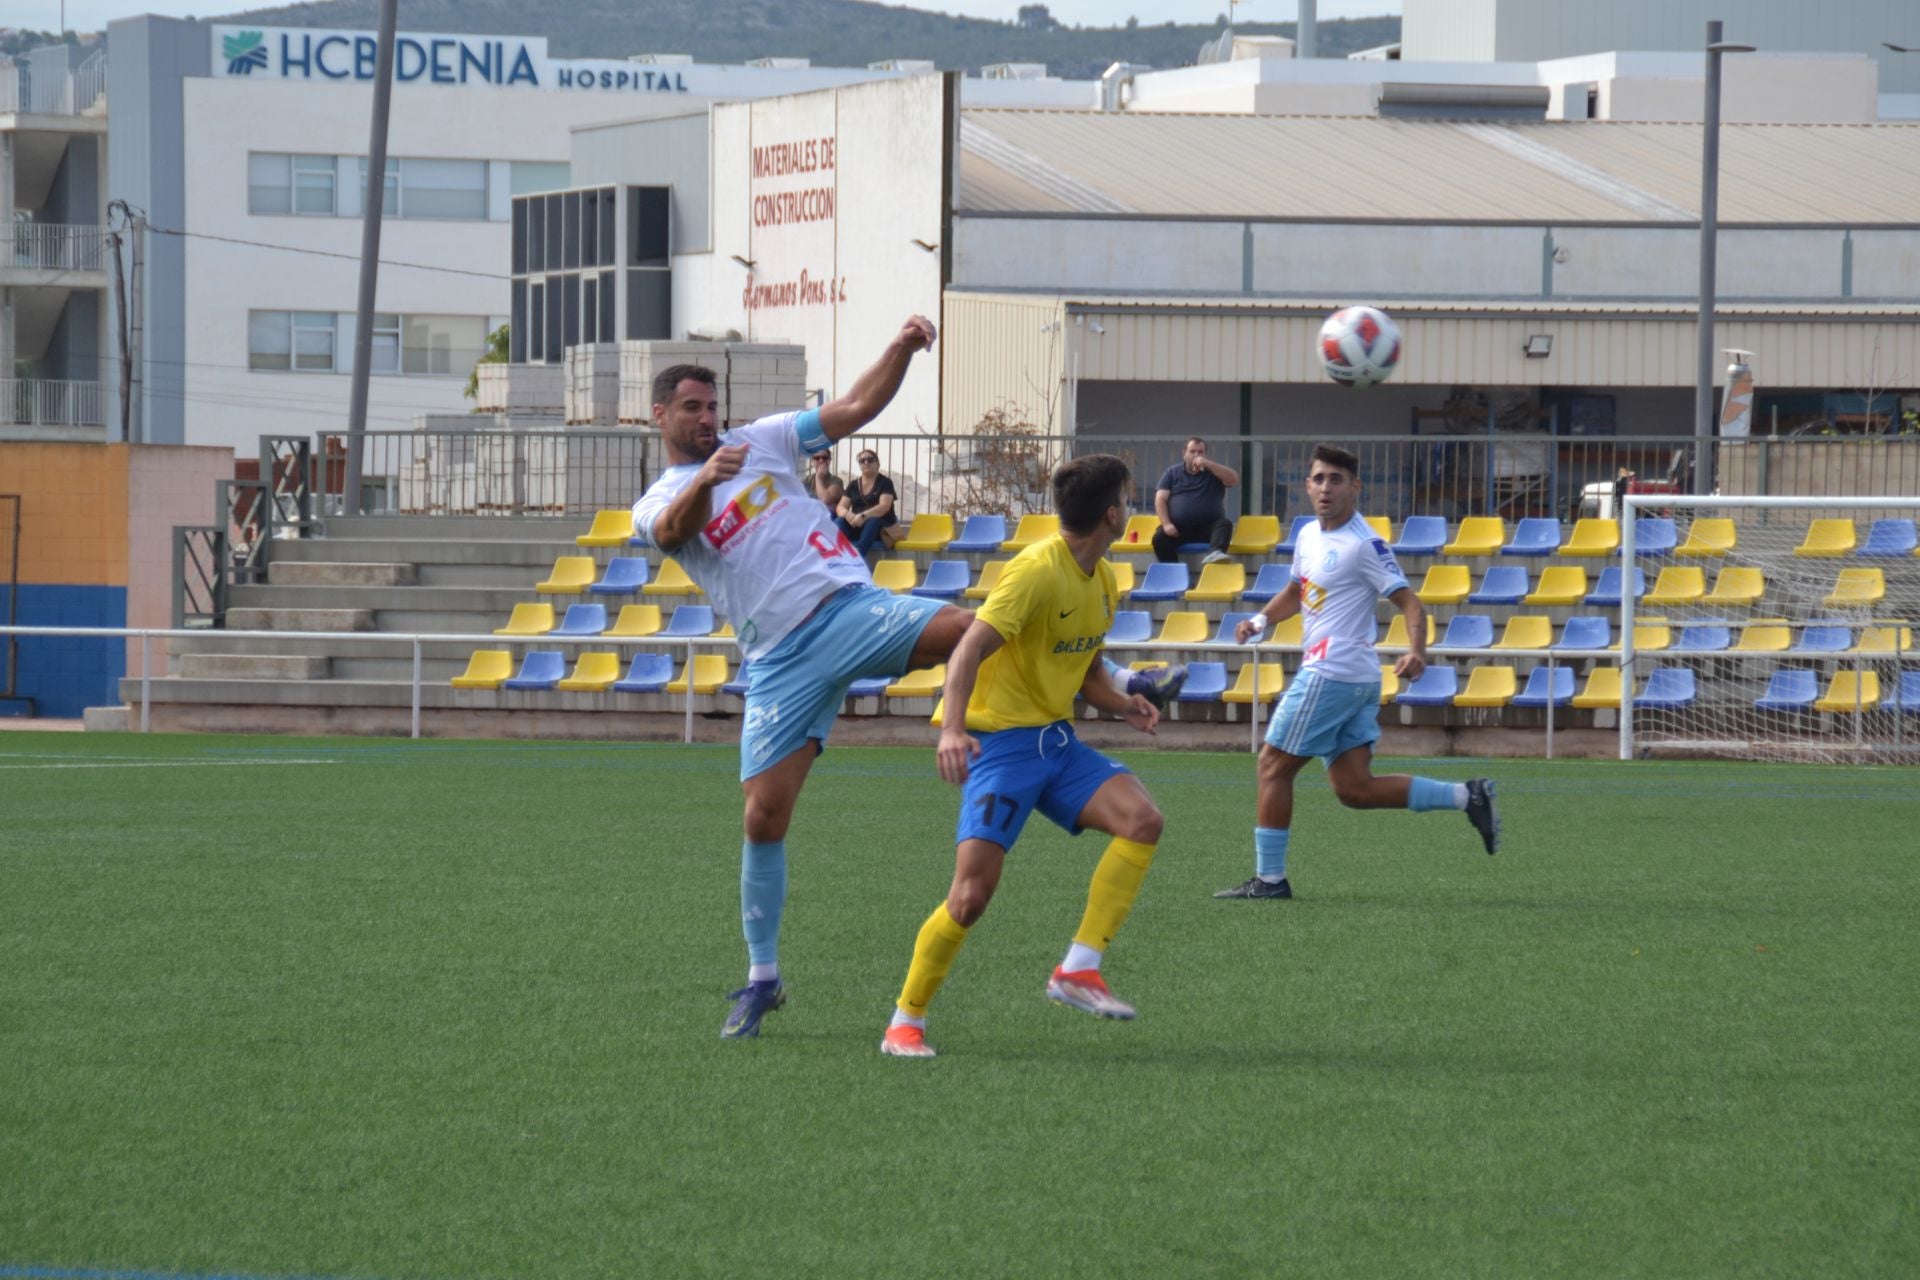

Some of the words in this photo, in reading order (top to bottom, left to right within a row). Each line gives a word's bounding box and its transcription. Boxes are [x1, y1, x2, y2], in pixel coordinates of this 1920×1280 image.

[281, 33, 376, 80] HCB
[394, 37, 539, 87] DENIA
[558, 68, 688, 92] HOSPITAL
[753, 139, 817, 179] MATERIALES
[820, 137, 834, 171] DE
[754, 188, 834, 227] CONSTRUCCION
[974, 791, 1020, 833] 17
